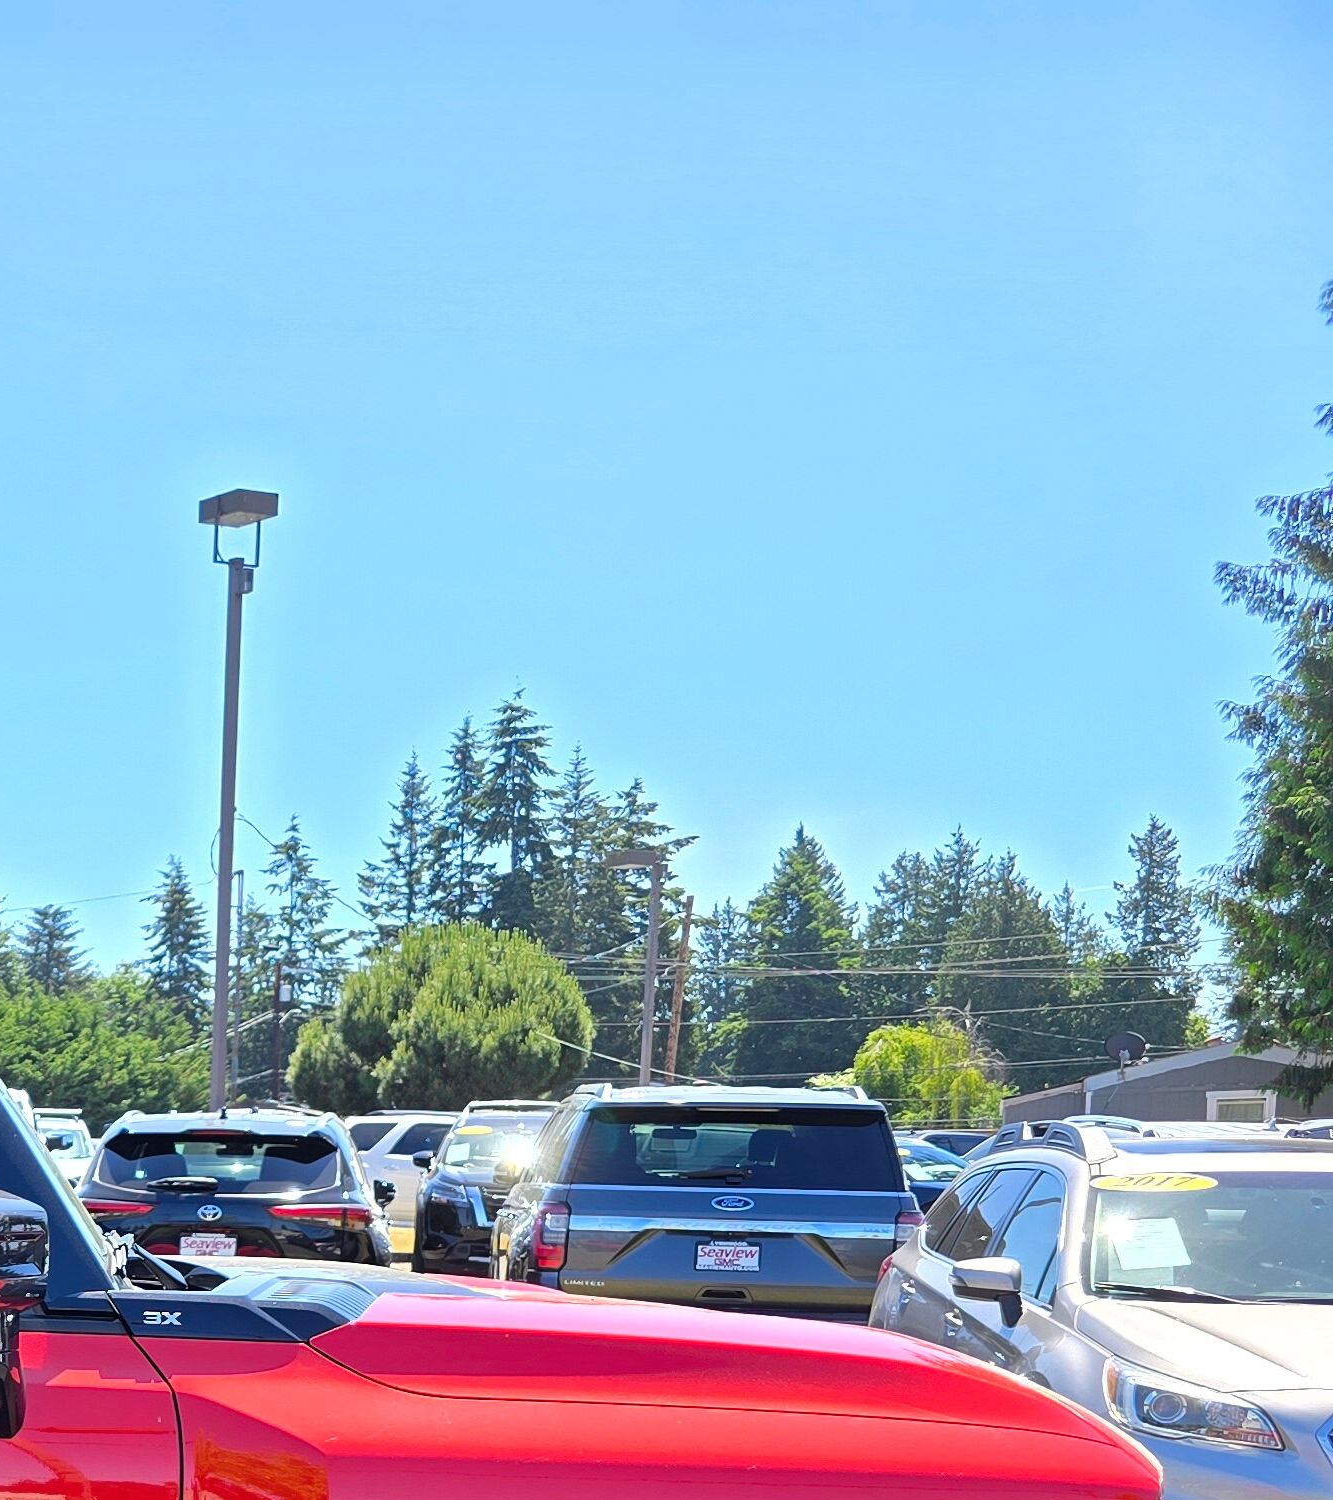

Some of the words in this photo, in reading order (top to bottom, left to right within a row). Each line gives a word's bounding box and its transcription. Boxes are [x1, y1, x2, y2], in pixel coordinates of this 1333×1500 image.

[1112, 1175, 1198, 1187] 2017
[719, 1197, 748, 1208] Ford
[182, 1238, 234, 1250] Seaview
[699, 1247, 757, 1259] Seaview
[714, 1258, 741, 1266] GMC
[142, 1311, 182, 1326] 3X
